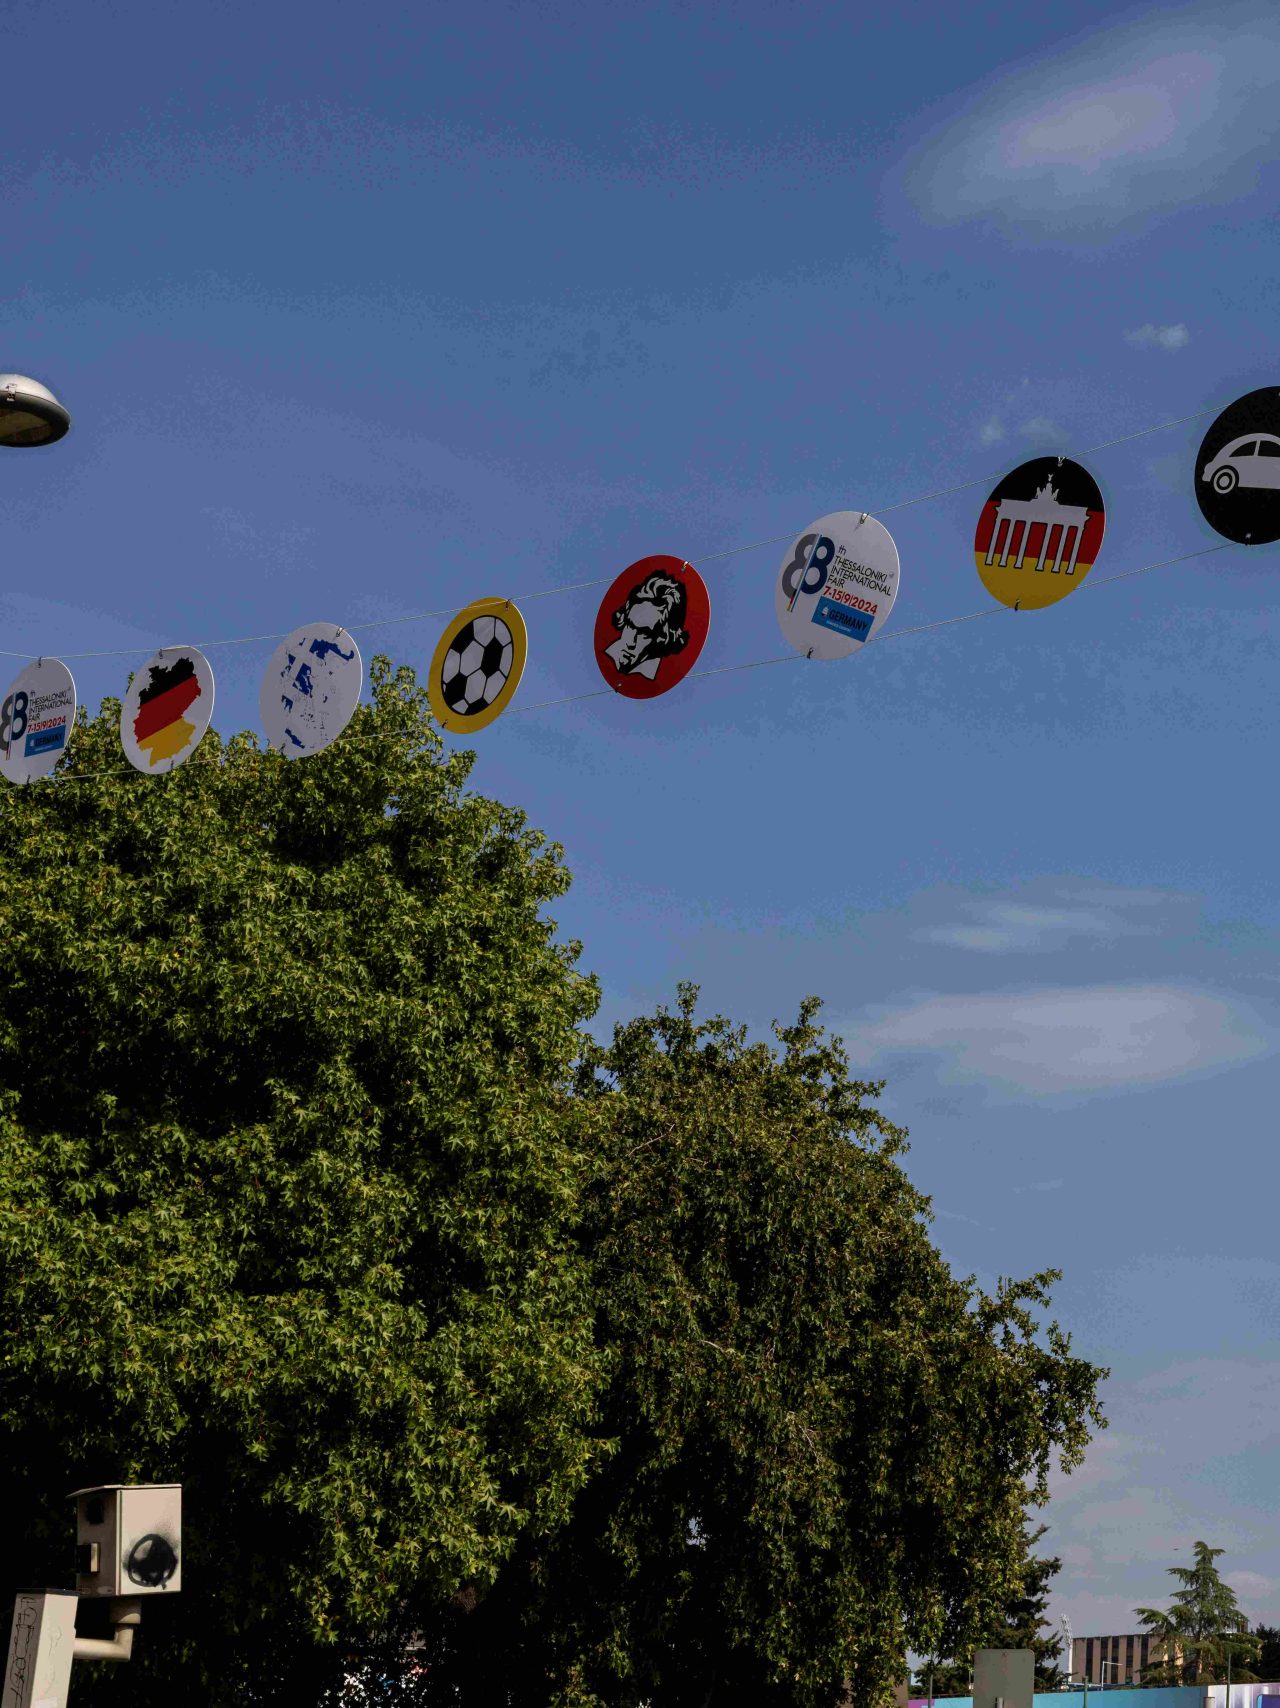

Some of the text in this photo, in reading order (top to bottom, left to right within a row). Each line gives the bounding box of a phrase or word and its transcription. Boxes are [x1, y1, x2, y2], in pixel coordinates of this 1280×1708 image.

[782, 533, 847, 600] 88 th
[834, 556, 888, 582] THESSALONIKI
[827, 574, 846, 588] FAIR
[831, 566, 892, 596] INTERNATIONAL
[828, 609, 868, 631] GERMANY
[29, 696, 72, 715] INTERNATIONAL
[30, 690, 67, 706] THESSALONIKI
[29, 713, 40, 722] FAIR
